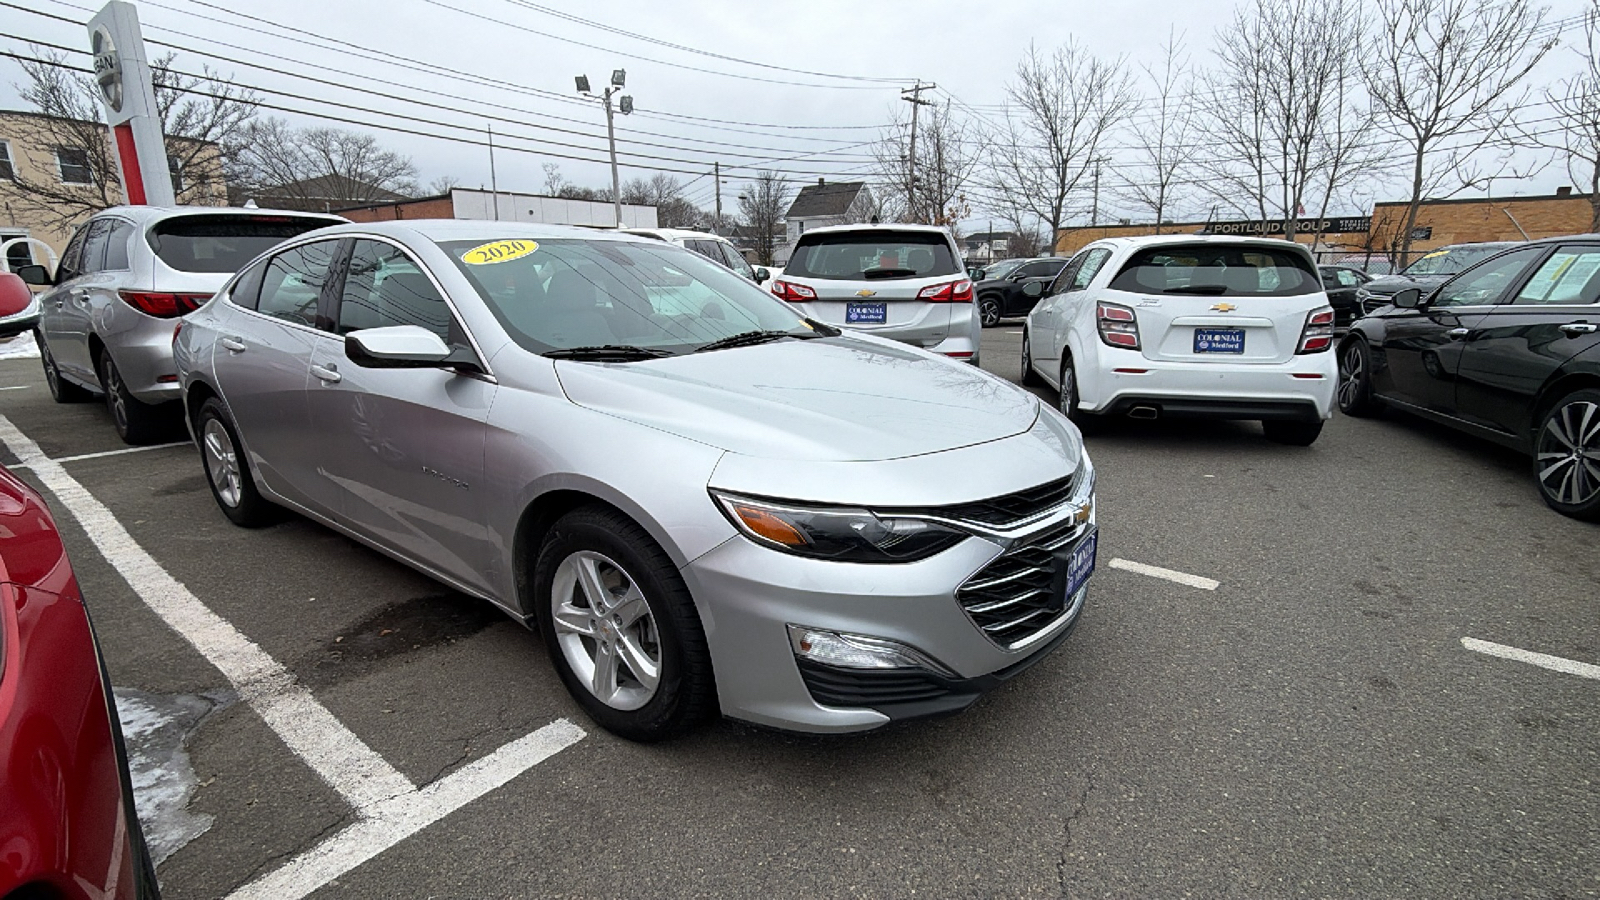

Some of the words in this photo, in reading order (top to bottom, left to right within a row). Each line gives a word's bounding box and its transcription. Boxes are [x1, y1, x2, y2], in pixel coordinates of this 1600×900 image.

[1214, 222, 1280, 233] PORTLAND
[476, 241, 526, 262] 2020
[1197, 334, 1242, 342] COLONIAL
